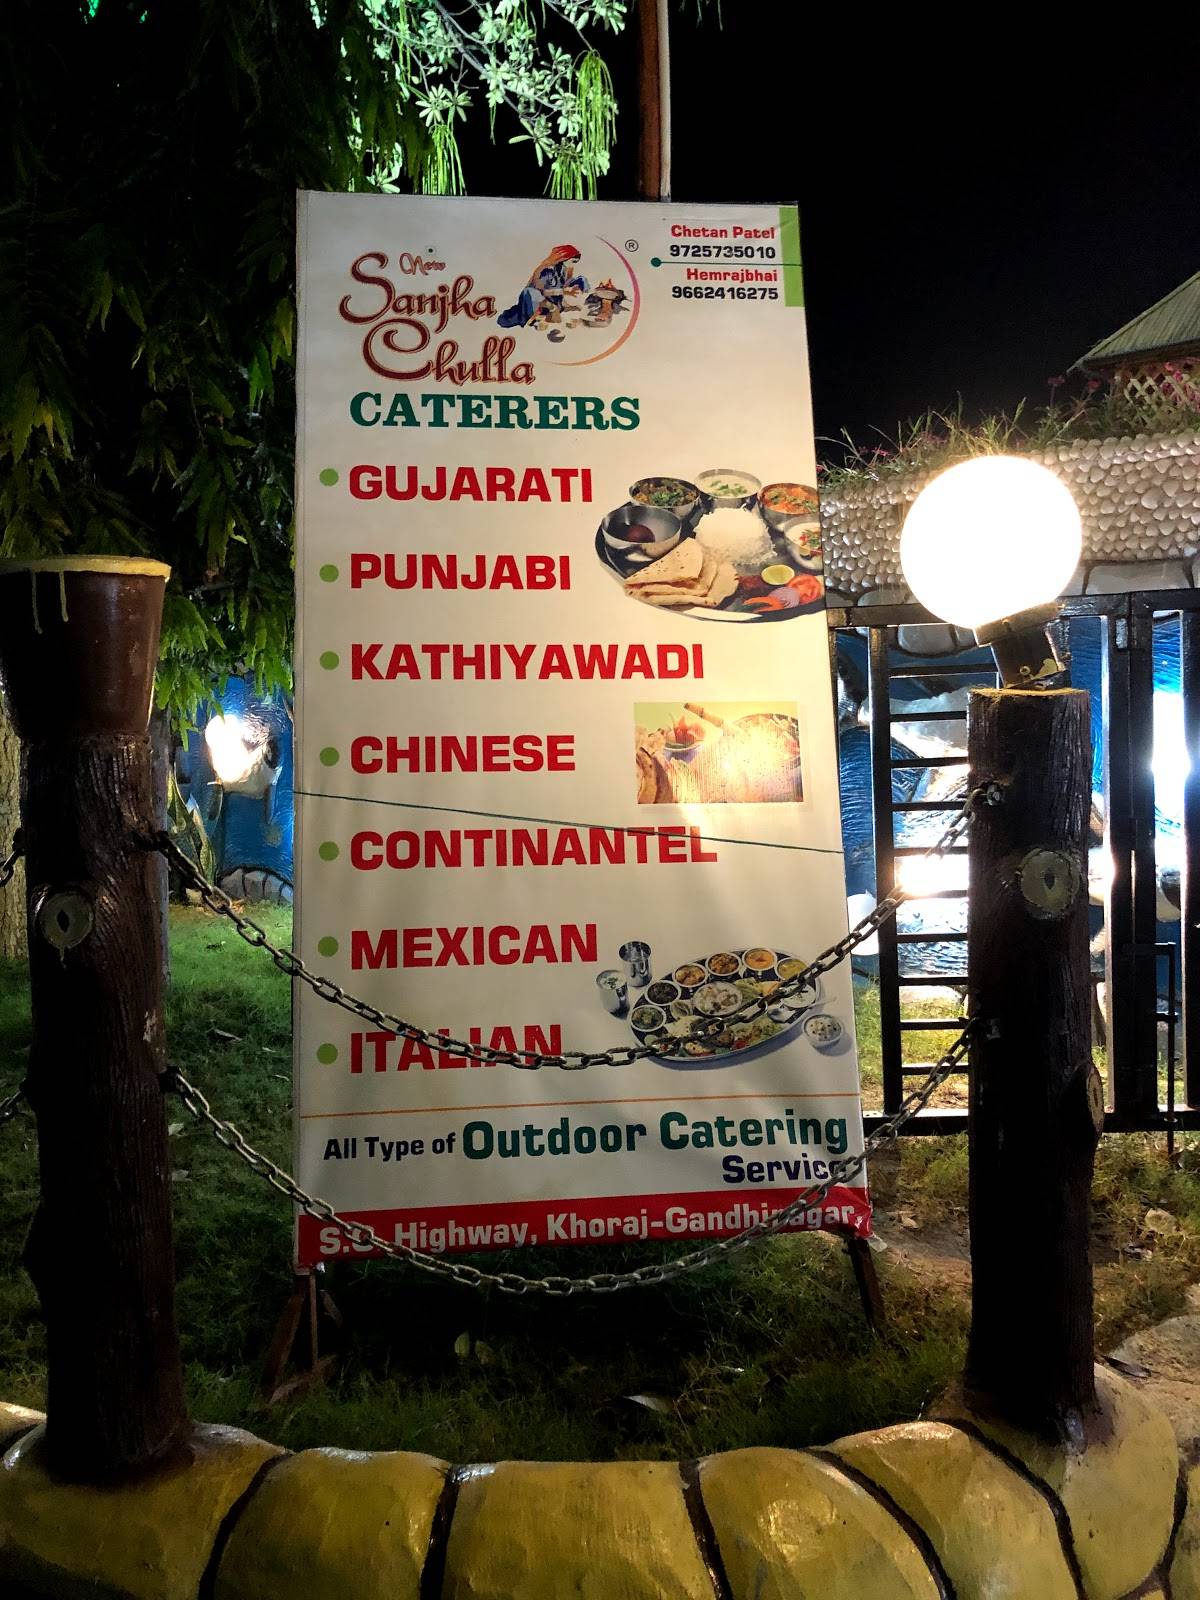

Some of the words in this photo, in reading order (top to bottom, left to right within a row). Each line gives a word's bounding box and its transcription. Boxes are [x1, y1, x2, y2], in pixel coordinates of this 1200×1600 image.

[671, 224, 728, 239] Chetan
[732, 226, 775, 239] Patel
[670, 244, 776, 259] 9725735010
[339, 251, 498, 334] Sanjha
[671, 286, 779, 300] 9662416275
[686, 268, 778, 284] Hemrajbhai
[362, 317, 537, 387] Chulla
[350, 391, 641, 431] CATERERS
[349, 464, 593, 503] GUJARATI
[350, 553, 571, 590] PUNJABI
[351, 643, 704, 680] KATHIYAWADI
[350, 735, 576, 774] CHINESE
[350, 826, 718, 871] CONTINANTEL
[351, 923, 598, 971] MEXICAN
[350, 1024, 562, 1074] ITALIAN
[323, 1137, 357, 1160] All
[364, 1136, 425, 1162] Type
[431, 1132, 456, 1154] of
[462, 1117, 647, 1160] Outdoor
[660, 1109, 848, 1154] Catering
[394, 1213, 537, 1251] Highway,
